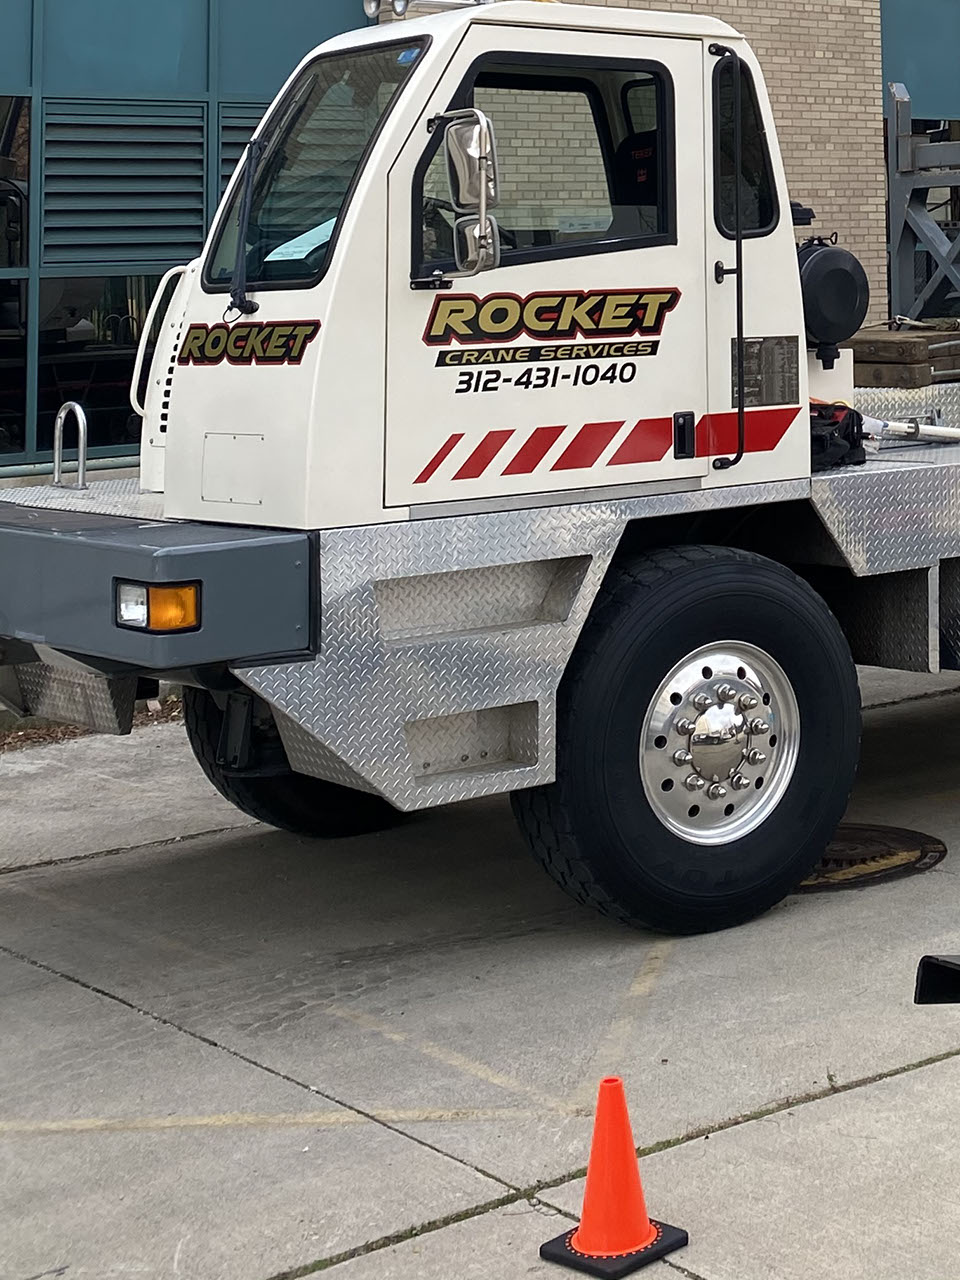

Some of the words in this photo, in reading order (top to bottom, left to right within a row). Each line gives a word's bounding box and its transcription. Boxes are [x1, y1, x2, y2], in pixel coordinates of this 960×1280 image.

[428, 291, 674, 338] ROCKET
[178, 323, 316, 360] ROCKET
[444, 348, 532, 366] CRANE
[538, 341, 654, 361] SERVICES
[454, 361, 638, 395] 312-431-1040
